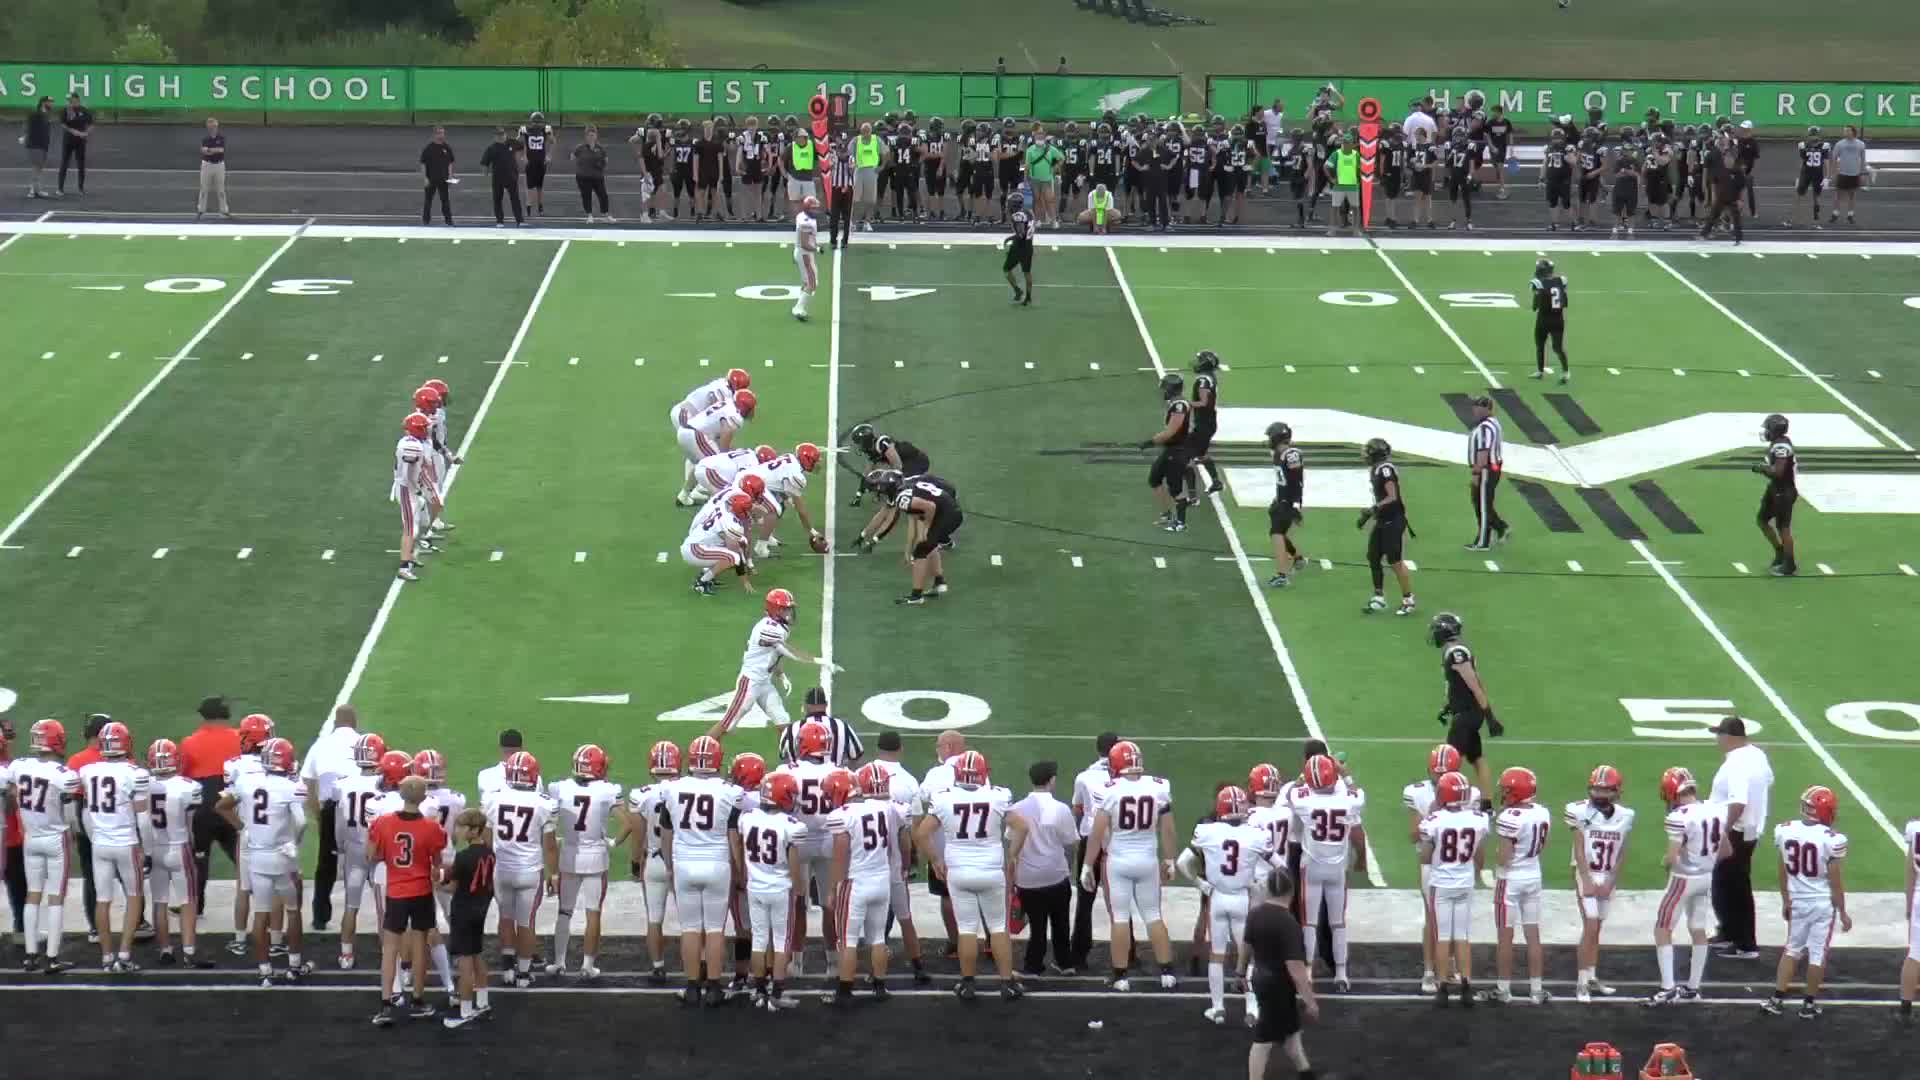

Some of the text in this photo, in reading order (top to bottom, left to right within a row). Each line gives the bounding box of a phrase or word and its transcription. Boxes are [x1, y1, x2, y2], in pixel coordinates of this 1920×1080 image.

[69, 73, 180, 98] HIGH
[212, 76, 397, 101] SCHOOL
[697, 80, 906, 106] EST. 1951
[1429, 88, 1920, 117] HOME OF THE ROCKE
[676, 147, 691, 162] 37
[897, 148, 911, 164] 14
[1097, 148, 1112, 164] 24
[1806, 151, 1821, 167] 39
[1550, 287, 1561, 309] 2
[19, 774, 49, 813] 27
[90, 775, 116, 813] 13
[151, 793, 167, 829] 5
[253, 788, 269, 825] 2
[678, 792, 714, 831] 79
[498, 804, 534, 842] 57
[574, 795, 591, 831] 7
[861, 810, 887, 851] 54
[953, 802, 990, 839] 77
[1119, 795, 1154, 830] 60
[1312, 809, 1346, 842] 35
[394, 832, 413, 868] 3
[745, 826, 778, 865] 43
[1220, 839, 1240, 876] 3
[1440, 828, 1475, 863] 83
[1589, 841, 1614, 871] 31
[1784, 839, 1818, 877] 30
